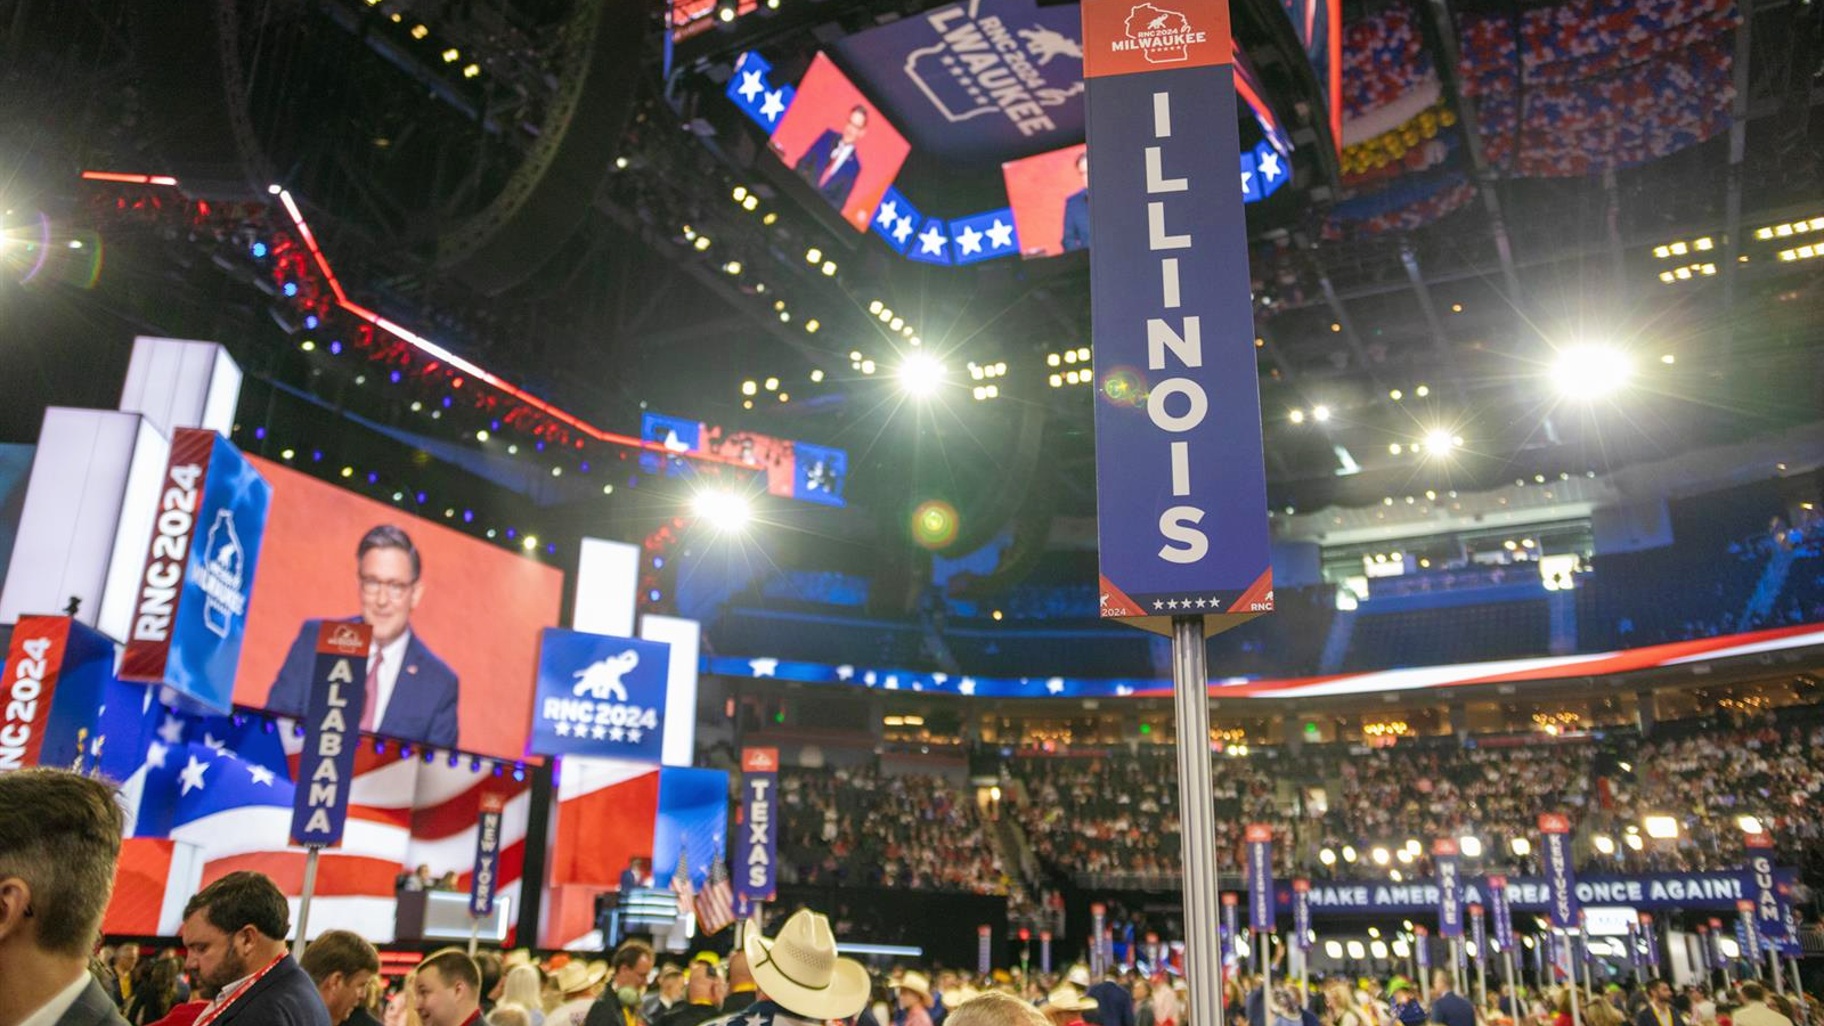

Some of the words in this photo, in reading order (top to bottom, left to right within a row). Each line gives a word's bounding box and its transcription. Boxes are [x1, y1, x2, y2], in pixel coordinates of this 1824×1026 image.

[978, 16, 1018, 53] RNC
[1002, 50, 1046, 88] 2024
[1111, 32, 1206, 52] MILWAUKEE
[1156, 28, 1178, 36] 2024
[927, 7, 1056, 136] LWAUKEE
[1145, 92, 1209, 564] ILLINOIS
[1102, 608, 1126, 617] 2024
[1250, 602, 1272, 611] RNC
[0, 637, 52, 769] NC2024
[304, 659, 353, 833] ALABAMA
[481, 814, 499, 852] NEW
[748, 779, 769, 887] TEXAS
[475, 856, 493, 911] YORK
[1308, 886, 1369, 906] MAKE
[1375, 884, 1482, 905] AMERA
[1574, 881, 1643, 903] ONCE
[1651, 878, 1743, 901] AGAIN!
[1439, 862, 1457, 925] MAINE
[1549, 834, 1571, 924] KENTUCKY
[1754, 857, 1780, 921] GUAM
